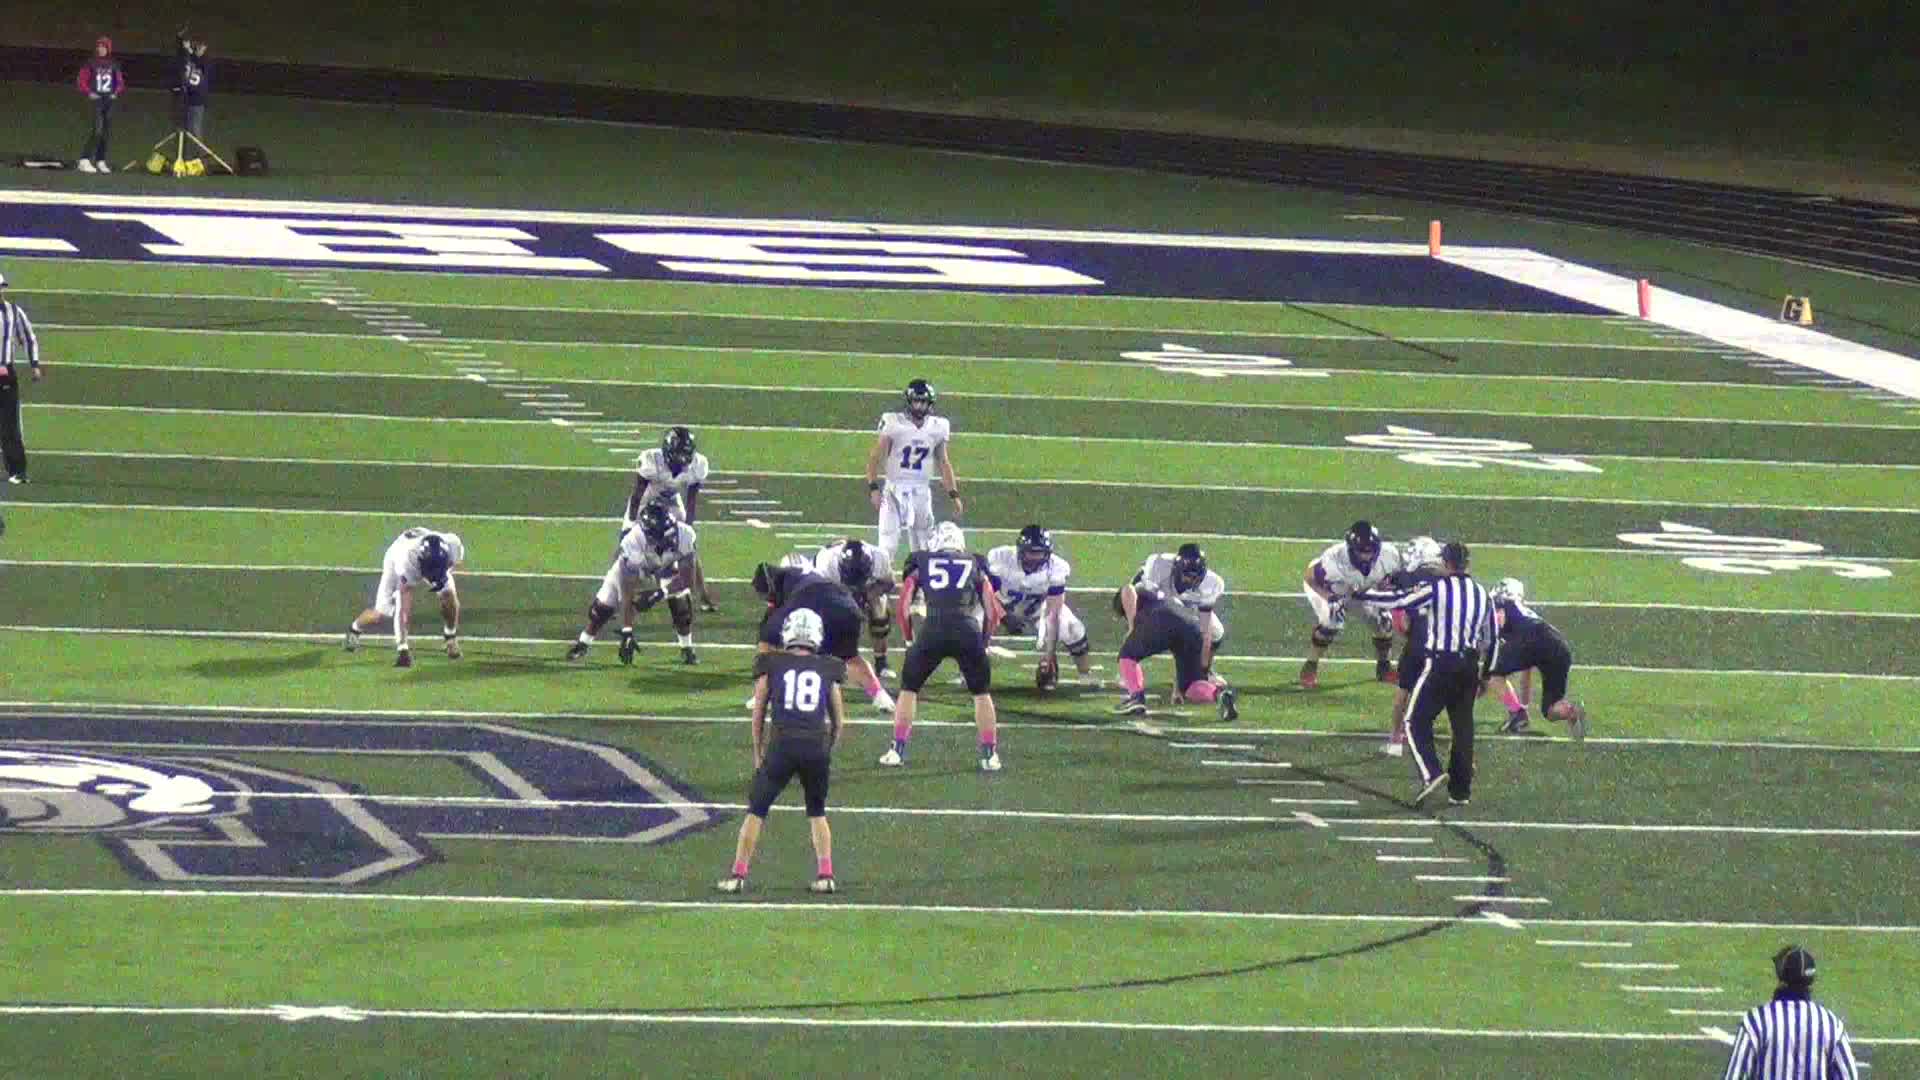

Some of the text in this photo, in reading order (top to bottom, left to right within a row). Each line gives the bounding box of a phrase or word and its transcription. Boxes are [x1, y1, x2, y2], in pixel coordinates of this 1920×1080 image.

[96, 72, 112, 92] 12
[900, 445, 930, 471] 17
[928, 558, 973, 590] 57
[783, 669, 822, 711] 18
